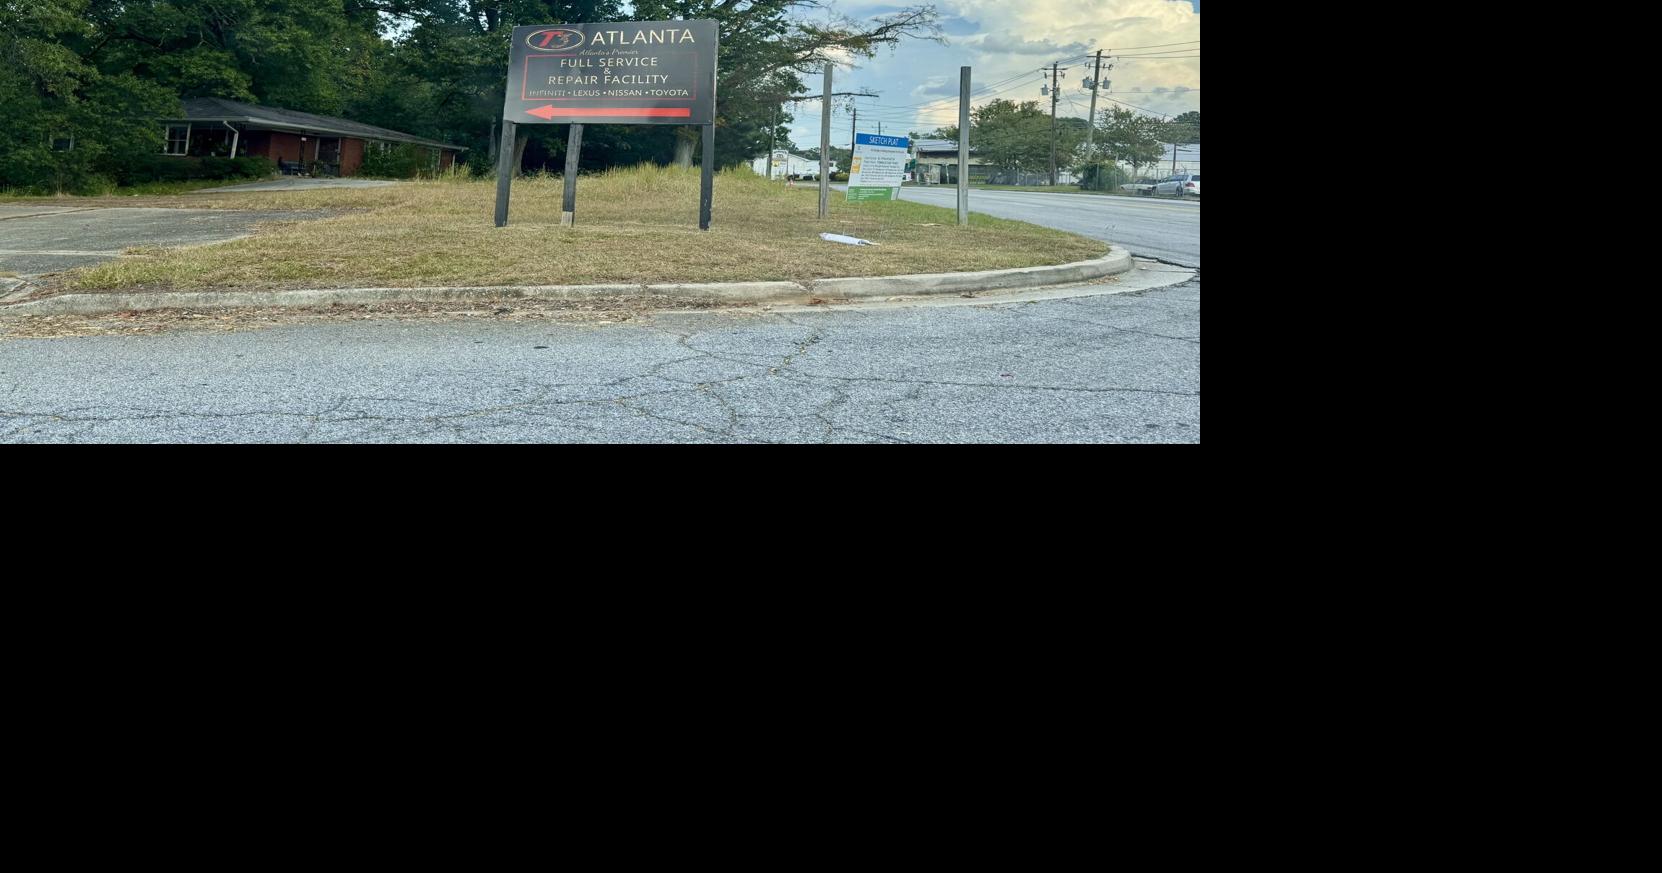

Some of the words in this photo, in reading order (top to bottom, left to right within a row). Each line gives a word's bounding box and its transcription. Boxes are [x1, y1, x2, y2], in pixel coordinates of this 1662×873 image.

[591, 29, 695, 46] ATLANTA
[560, 58, 593, 68] FULL
[599, 57, 659, 67] SERVICE
[548, 75, 598, 85] REPAIR
[604, 74, 669, 84] FACILITY
[869, 136, 887, 144] SKETCH
[887, 137, 899, 145] PLAT
